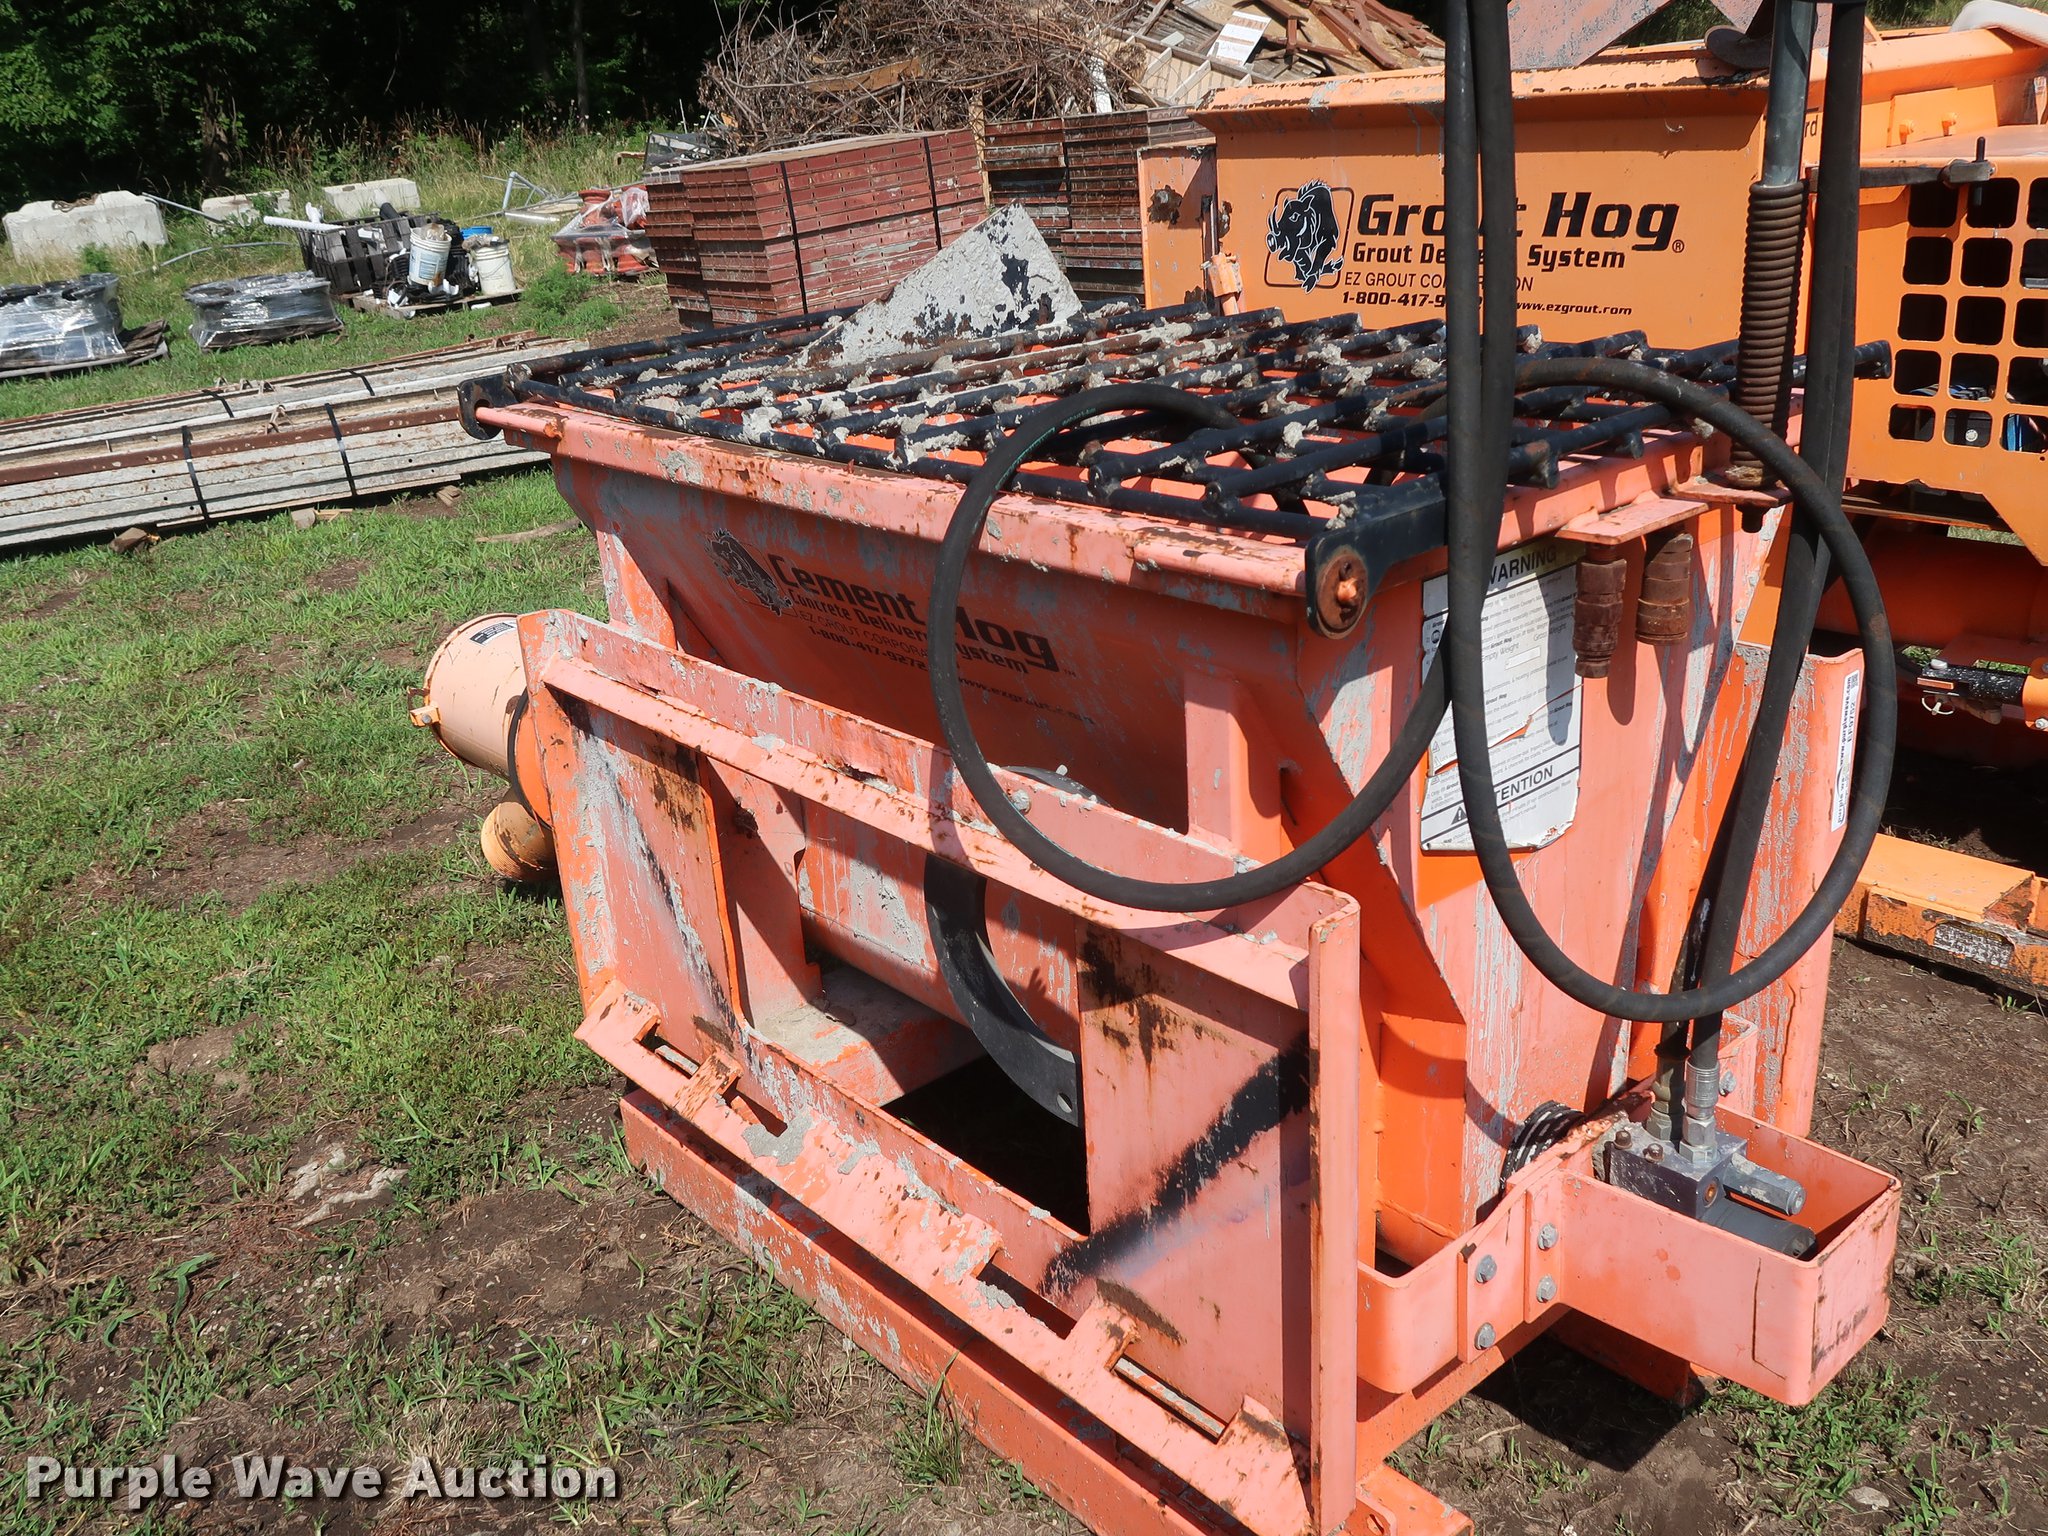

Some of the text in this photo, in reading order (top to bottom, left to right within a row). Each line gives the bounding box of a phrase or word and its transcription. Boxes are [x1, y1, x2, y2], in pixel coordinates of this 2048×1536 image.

[1344, 271, 1362, 286] EZ
[1365, 272, 1417, 288] GROUT
[1352, 242, 1413, 264] Grout
[1527, 244, 1626, 273] System
[768, 553, 926, 626] Cement
[788, 588, 1030, 675] Concrete Deliver ystem
